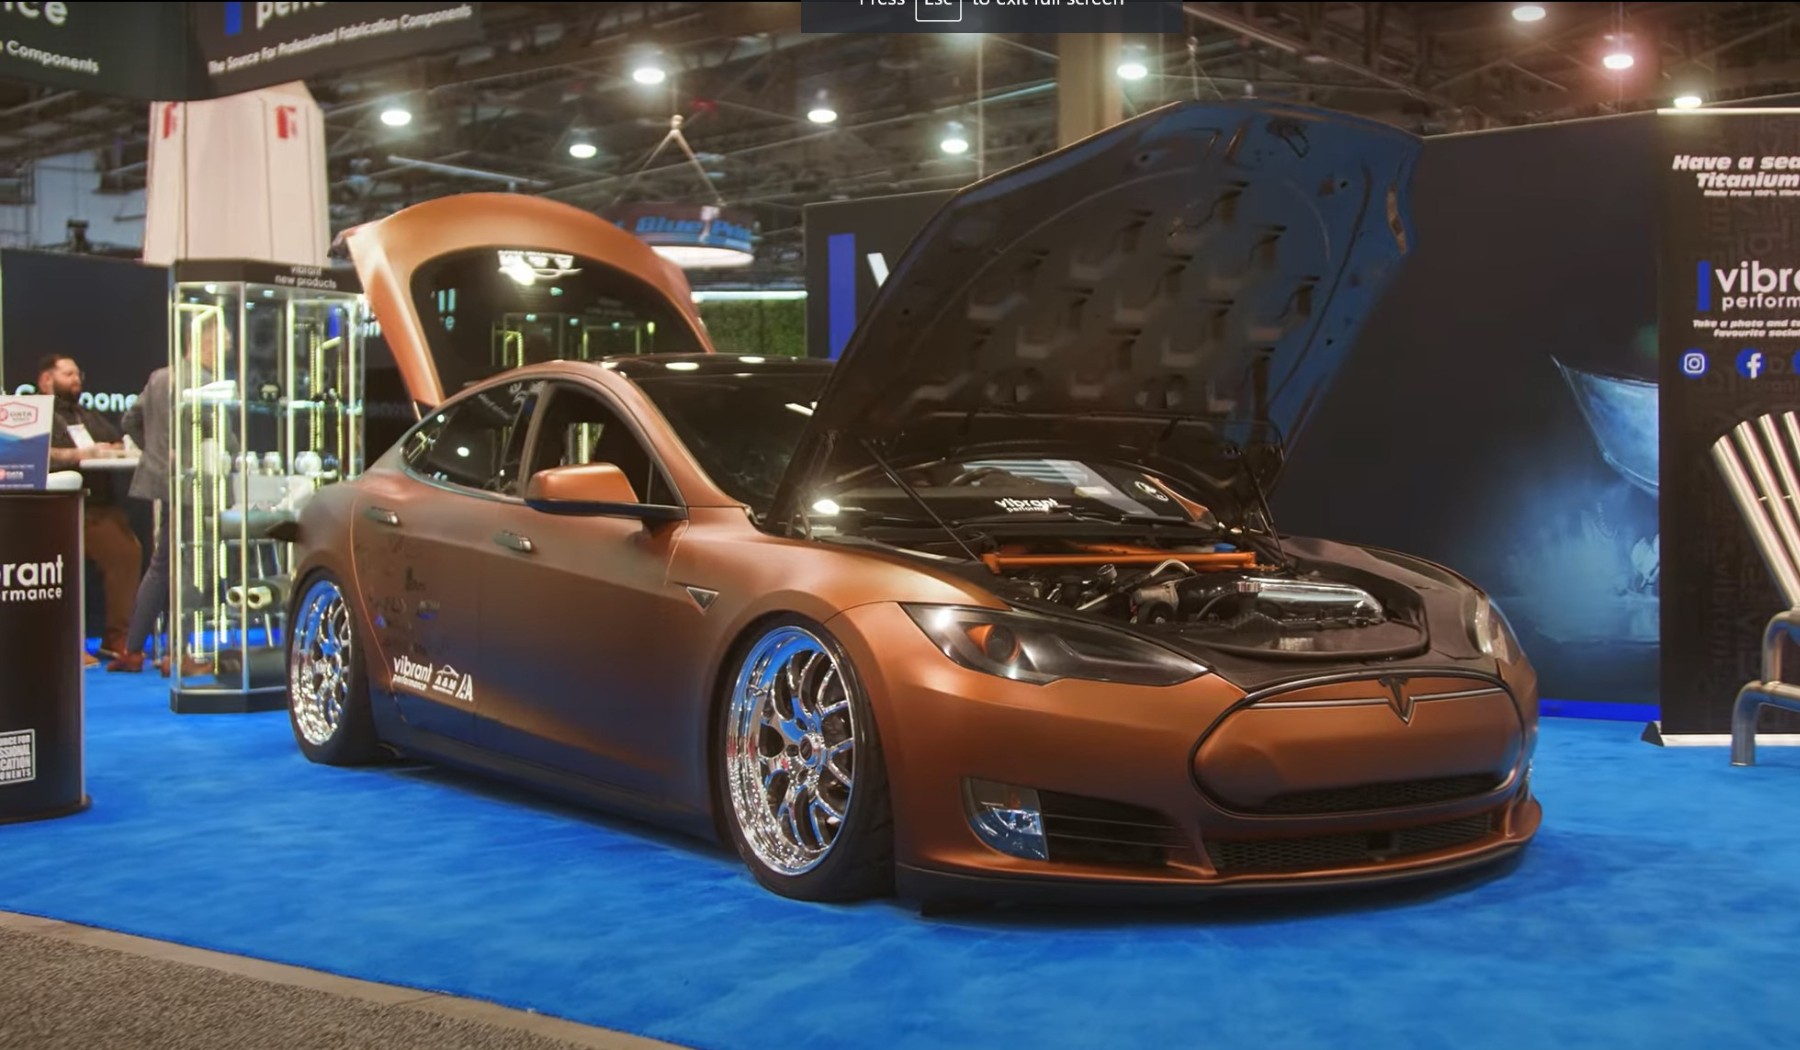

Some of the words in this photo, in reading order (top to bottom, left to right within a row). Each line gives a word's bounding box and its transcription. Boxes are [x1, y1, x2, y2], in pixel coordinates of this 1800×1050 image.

[208, 60, 226, 75] The
[226, 51, 260, 71] Source
[260, 46, 277, 60] For
[277, 27, 338, 56] Professional
[338, 18, 398, 41] Fabrication
[400, 3, 472, 30] Components
[6, 40, 99, 74] Components
[1672, 154, 1732, 170] Have
[1738, 156, 1754, 170] a
[1696, 171, 1800, 188] Titanium
[274, 275, 295, 285] new
[296, 277, 337, 289] products
[1693, 319, 1718, 328] Take
[1730, 319, 1764, 329] photo
[1766, 319, 1788, 328] and
[1713, 328, 1766, 338] favourite
[994, 497, 1059, 509] vibrant
[0, 554, 64, 587] rant
[393, 655, 433, 683] vibrant
